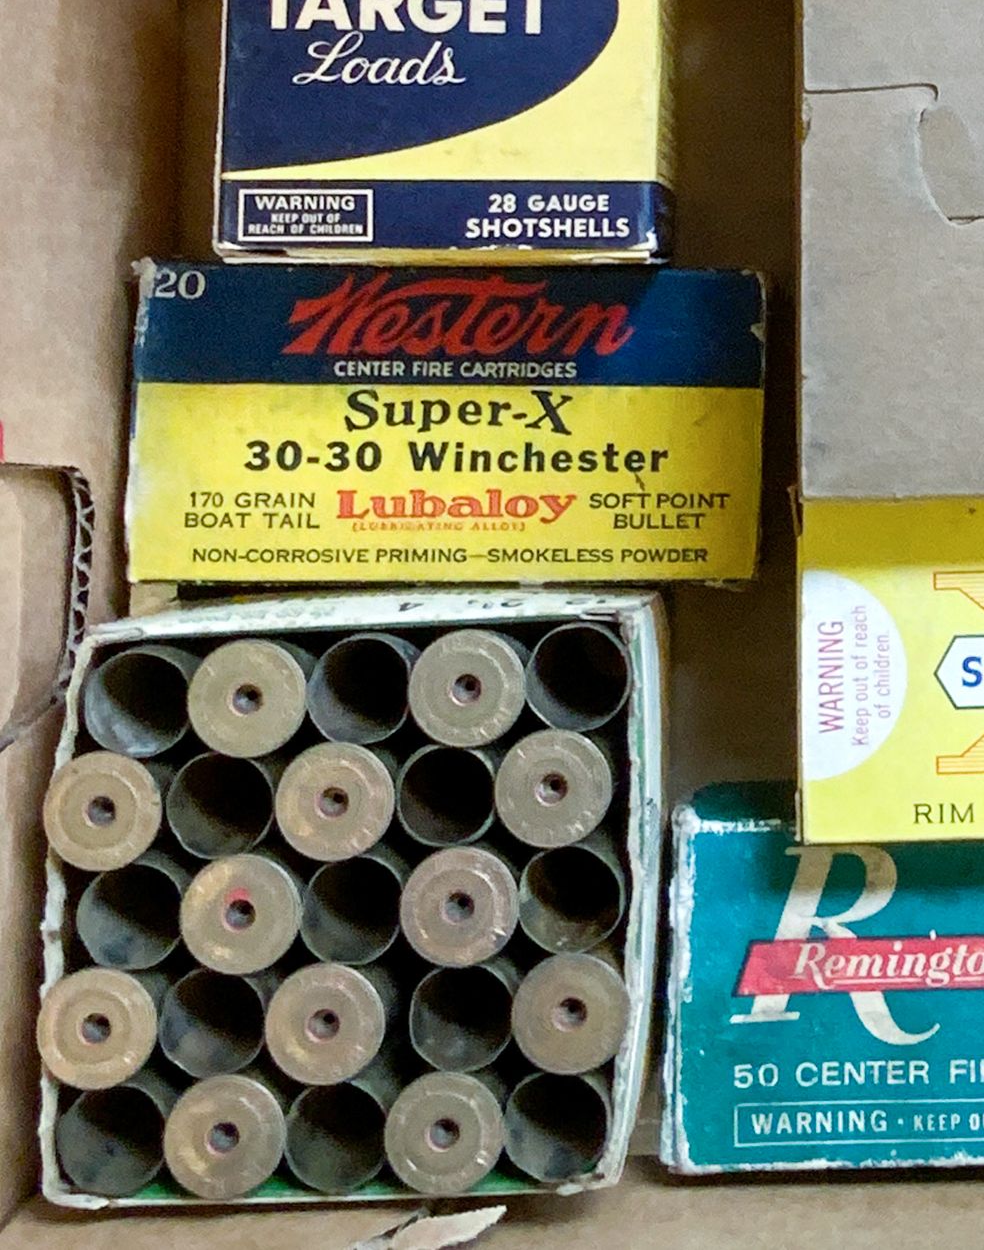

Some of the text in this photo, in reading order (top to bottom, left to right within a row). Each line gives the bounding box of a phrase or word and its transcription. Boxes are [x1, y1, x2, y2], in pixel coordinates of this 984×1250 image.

[292, 30, 466, 85] Loads
[254, 195, 356, 211] WARNING
[488, 194, 610, 213] 28 GAUGE
[248, 224, 364, 235] REACH OF CHILDREN
[271, 212, 341, 224] KEEP OUT OF
[465, 217, 630, 239] SHOTSHELLS
[153, 269, 206, 299] 20
[282, 271, 637, 355] Western
[334, 360, 578, 379] CENTER FIRE CARTRIDGES
[344, 388, 574, 436] Super-X
[245, 440, 669, 474] 30-30 Winchester
[189, 491, 316, 509] 170 GRAIN
[337, 489, 577, 524] Lubaloy
[589, 491, 731, 510] SOFT POINT
[184, 512, 320, 530] BOAT TAIL
[612, 512, 705, 531] BULLET
[192, 547, 371, 564] NON-CORROSIVE
[620, 548, 709, 565] POWDER
[817, 621, 844, 734] WARNING
[851, 605, 872, 746] Keep out of reach
[874, 703, 891, 719] of
[913, 800, 975, 825] RIM
[729, 846, 940, 1046] R
[733, 1063, 780, 1089] 50
[796, 1060, 930, 1086] CENTER
[751, 1110, 889, 1136] WARNING
[913, 1113, 961, 1133] KEEP
